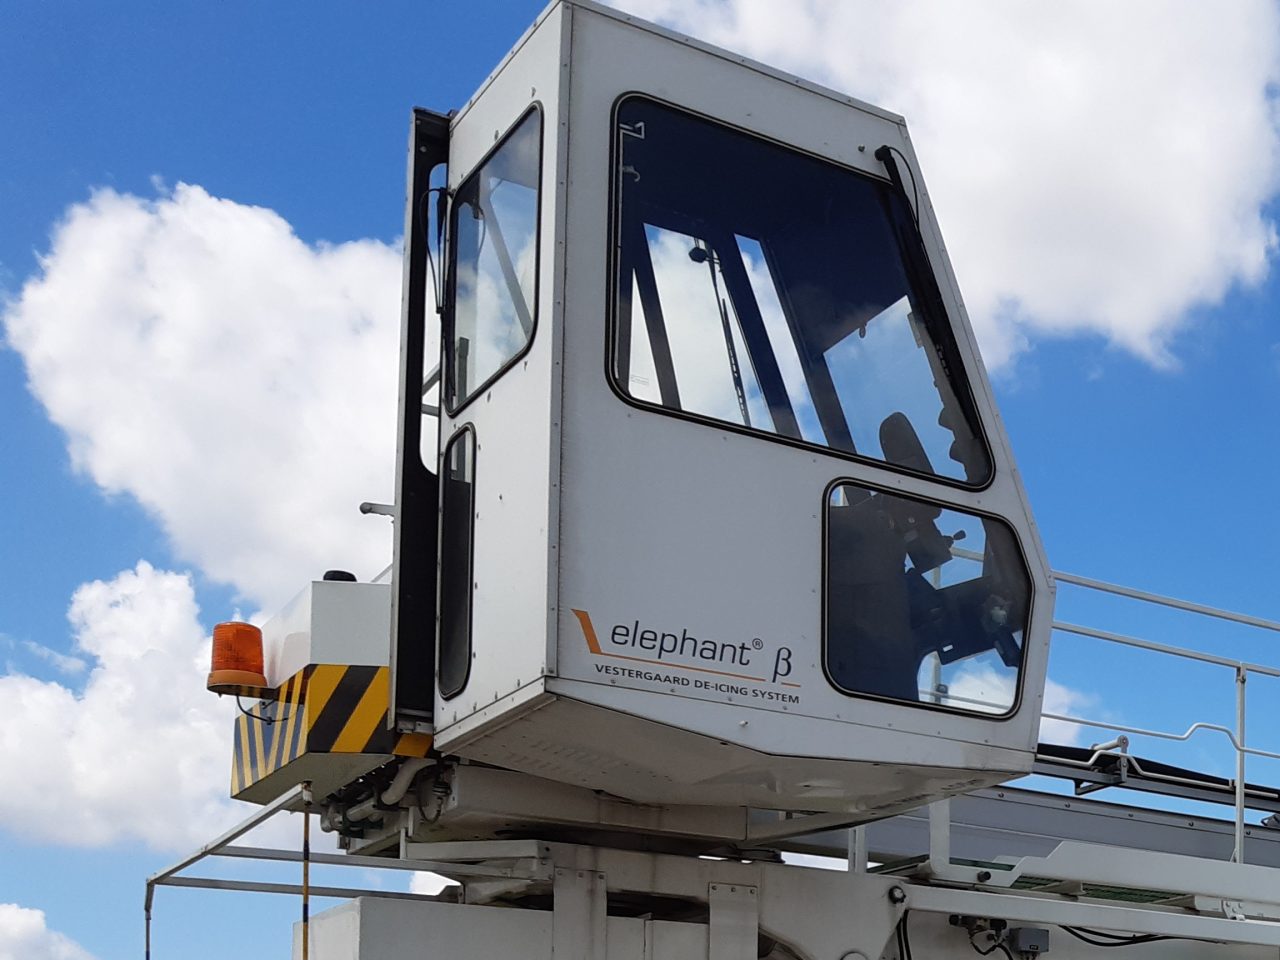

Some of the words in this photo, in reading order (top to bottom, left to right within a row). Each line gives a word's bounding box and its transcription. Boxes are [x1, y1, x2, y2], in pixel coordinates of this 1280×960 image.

[594, 663, 690, 687] VESTERGAARD
[694, 678, 749, 697] DE-ICING
[751, 688, 801, 704] SYSTEM
